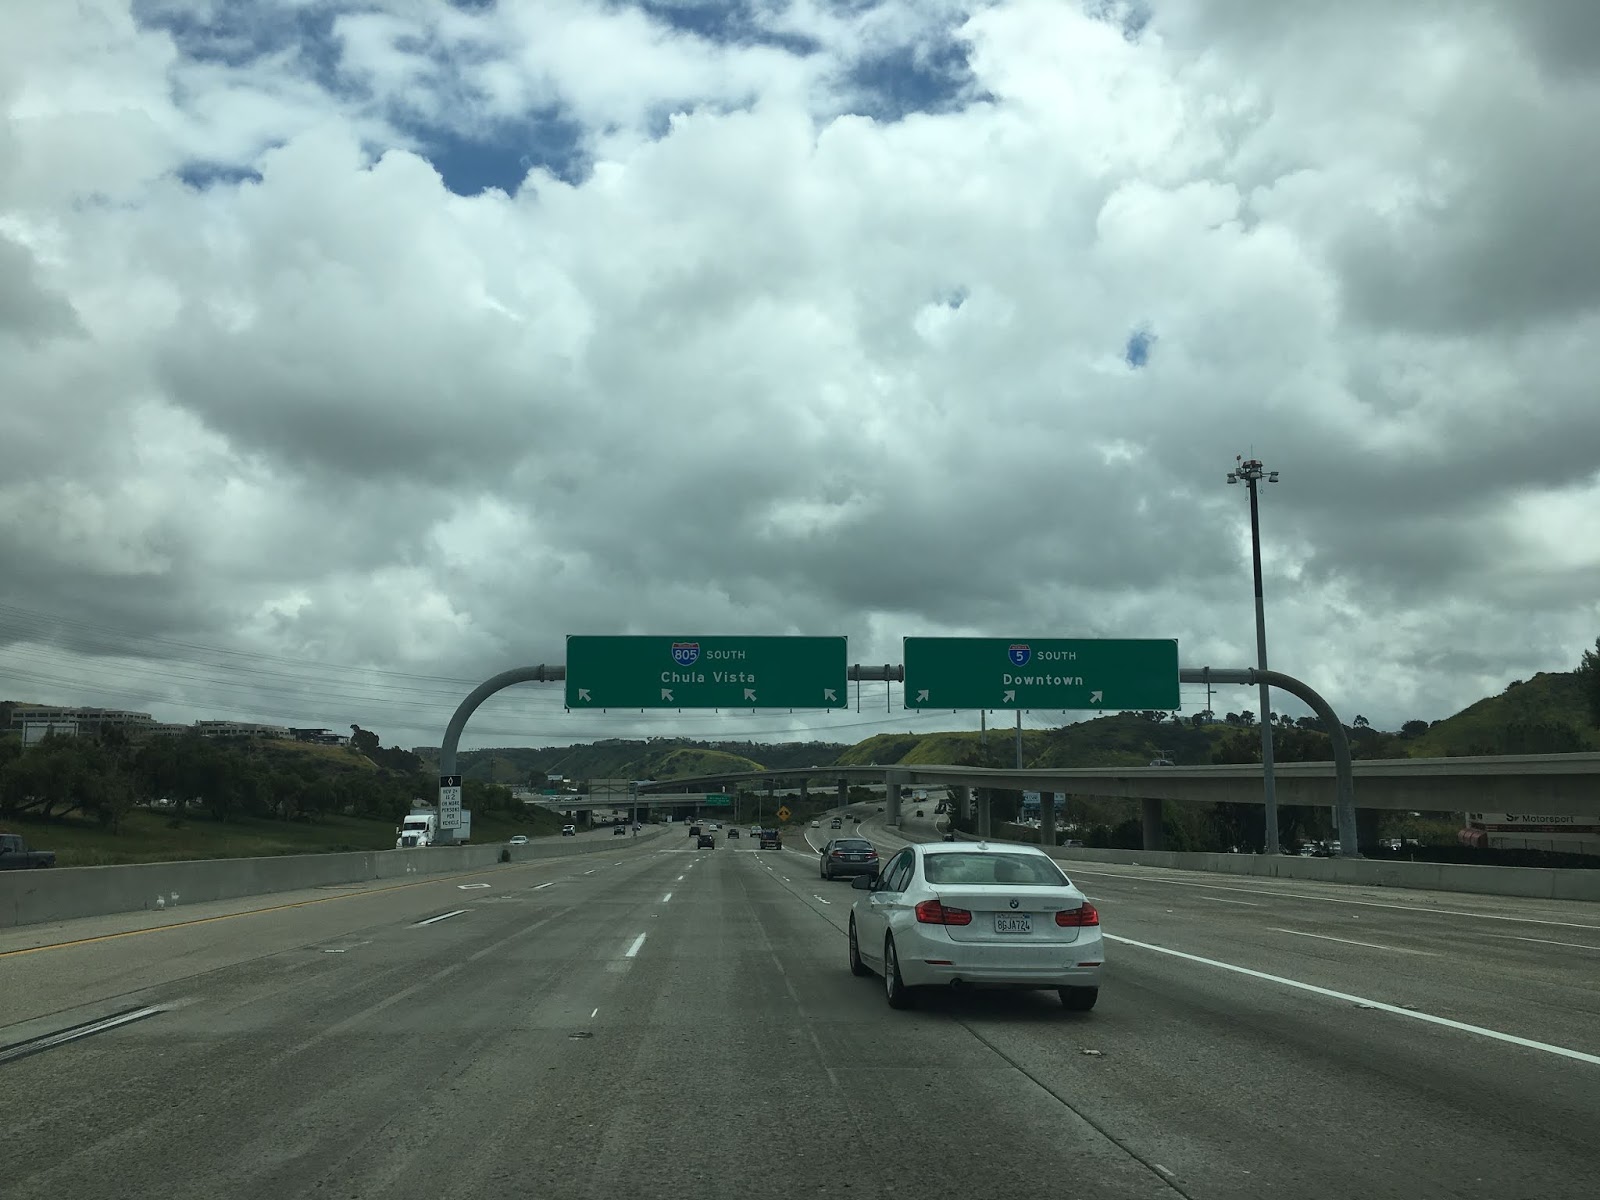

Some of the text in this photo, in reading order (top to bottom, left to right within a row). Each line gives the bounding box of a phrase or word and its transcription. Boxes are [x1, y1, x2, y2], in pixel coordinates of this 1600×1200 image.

[674, 649, 746, 660] 805 SOUTH
[1016, 651, 1077, 662] 5 SOUTH
[661, 671, 755, 683] Chula Vista
[1003, 673, 1084, 686] Downtown
[1522, 814, 1575, 824] Motorsport
